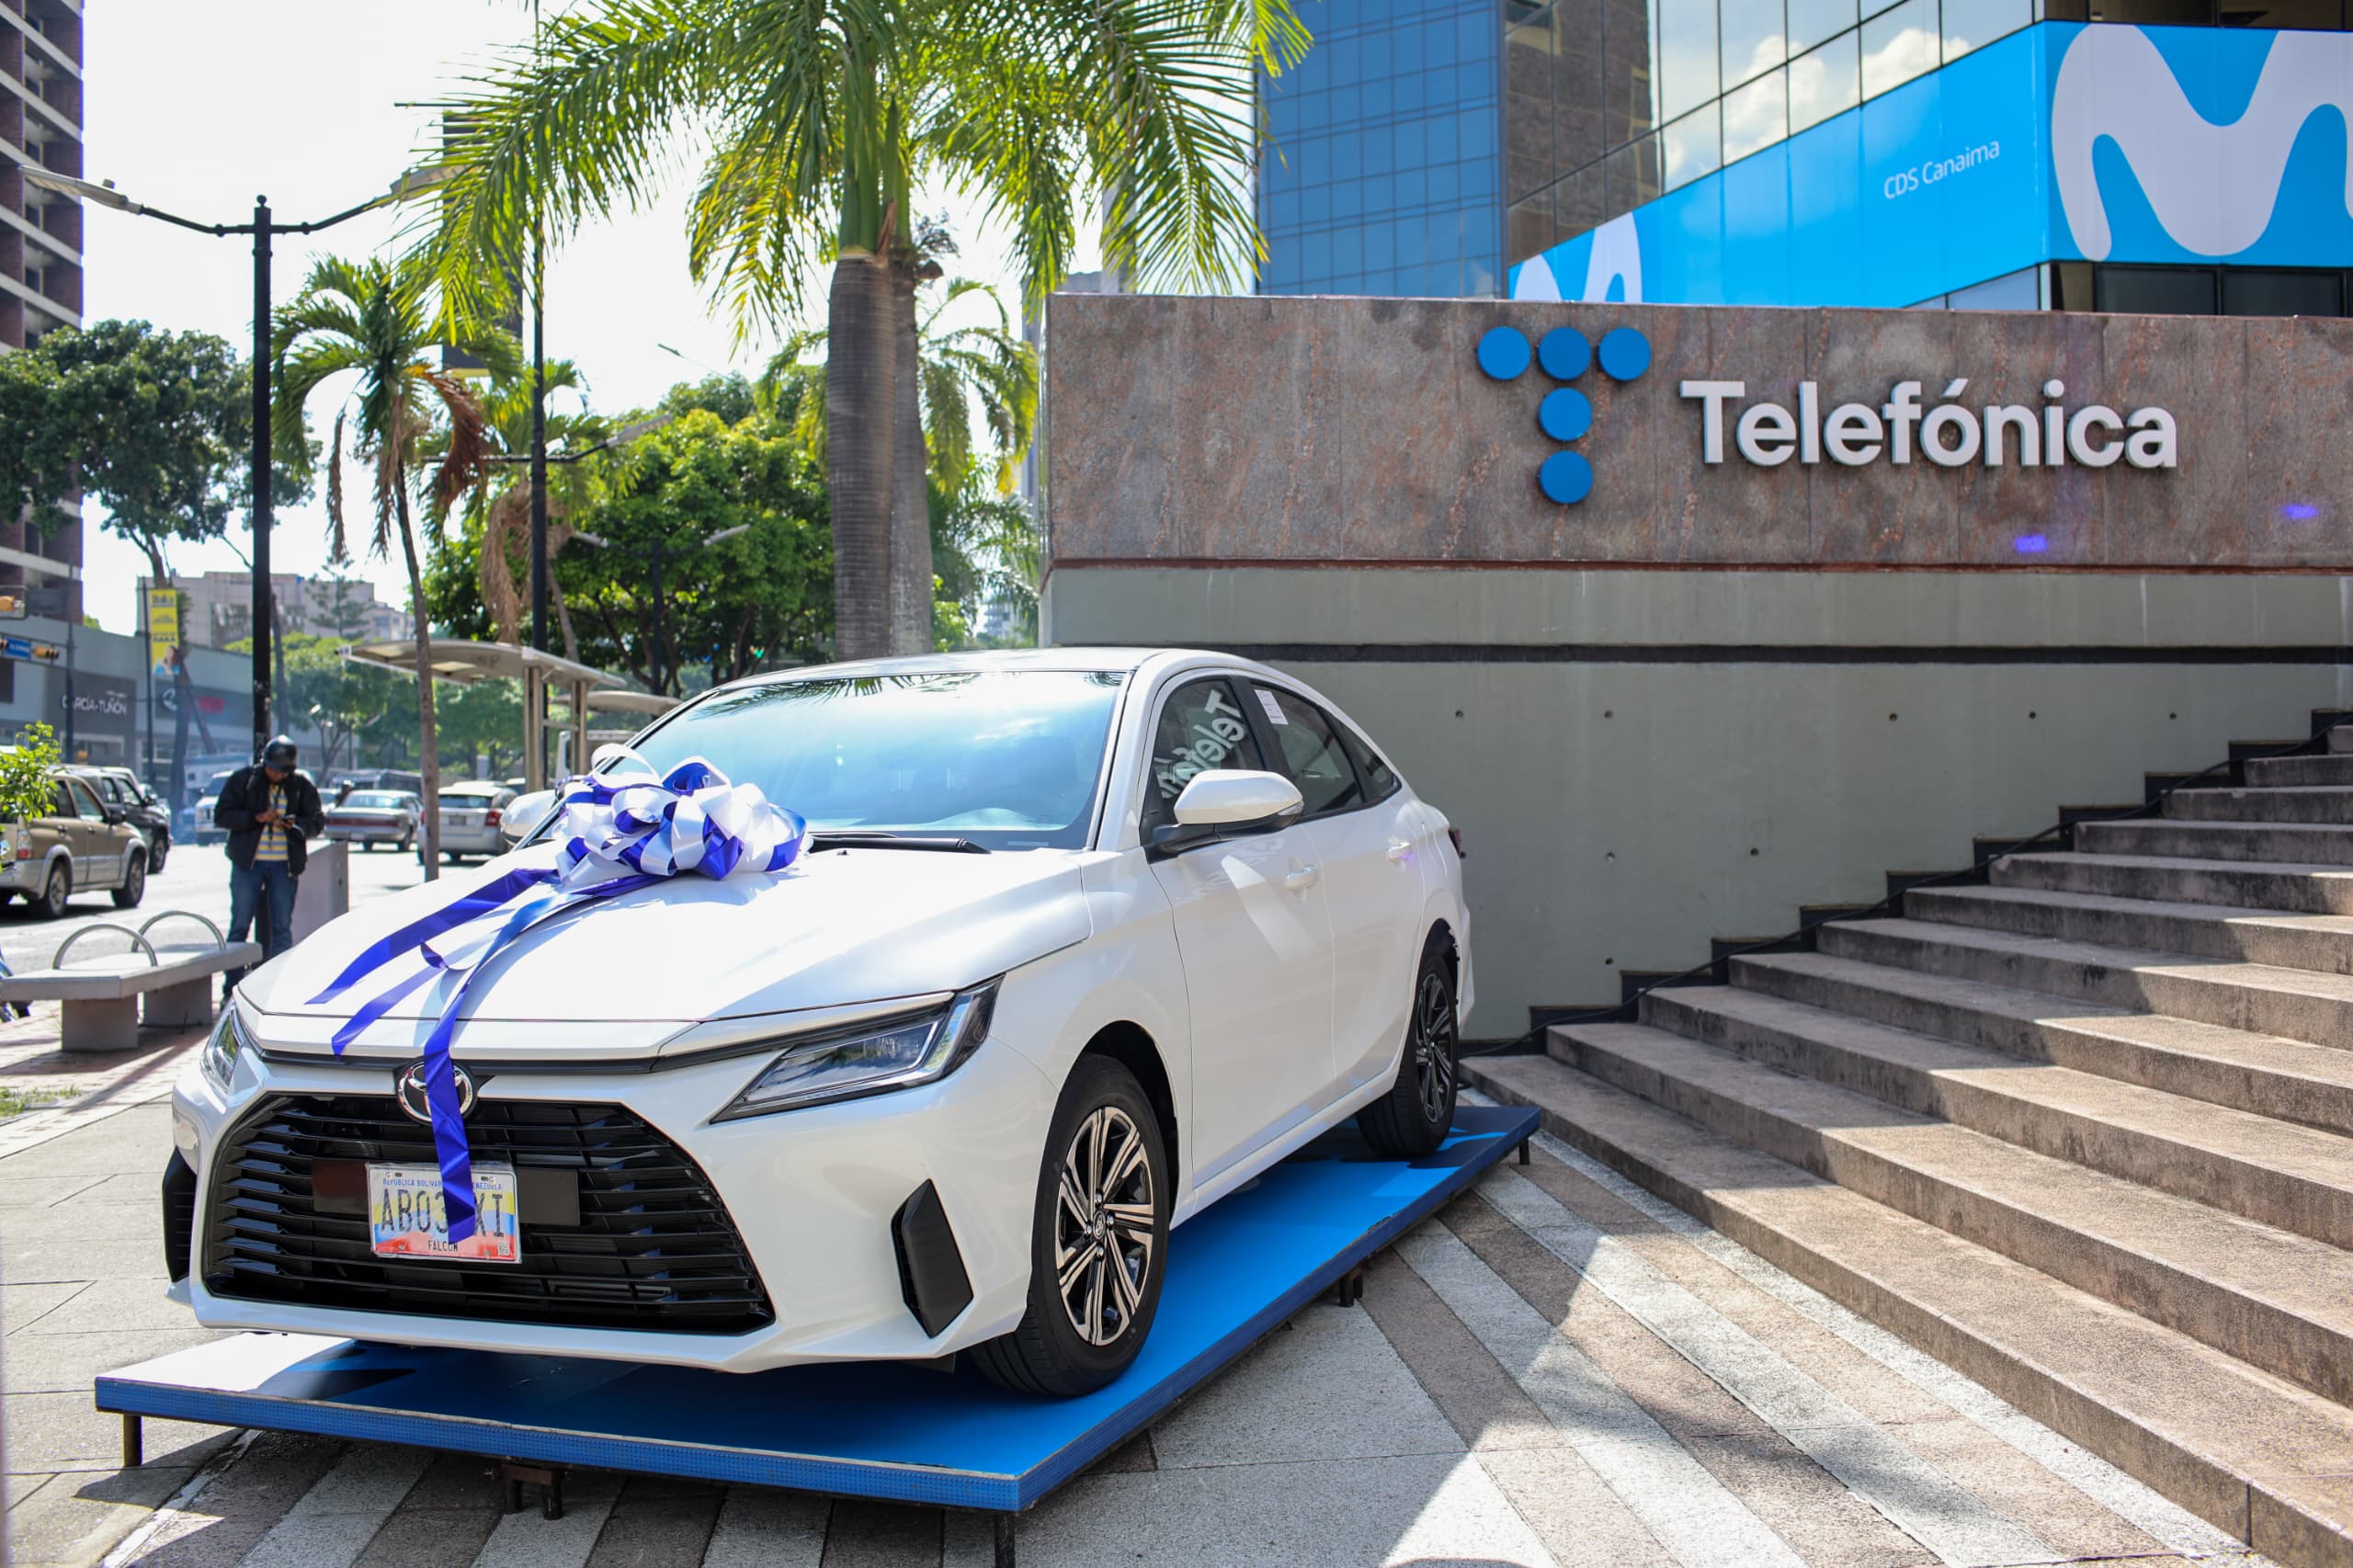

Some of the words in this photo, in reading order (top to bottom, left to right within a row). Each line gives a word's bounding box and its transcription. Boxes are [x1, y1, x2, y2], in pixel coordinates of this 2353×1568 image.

[1883, 166, 1919, 199] CDS
[1922, 140, 2000, 185] Canaima
[1680, 377, 2177, 468] Telefónica
[381, 1187, 505, 1238] AB03XI
